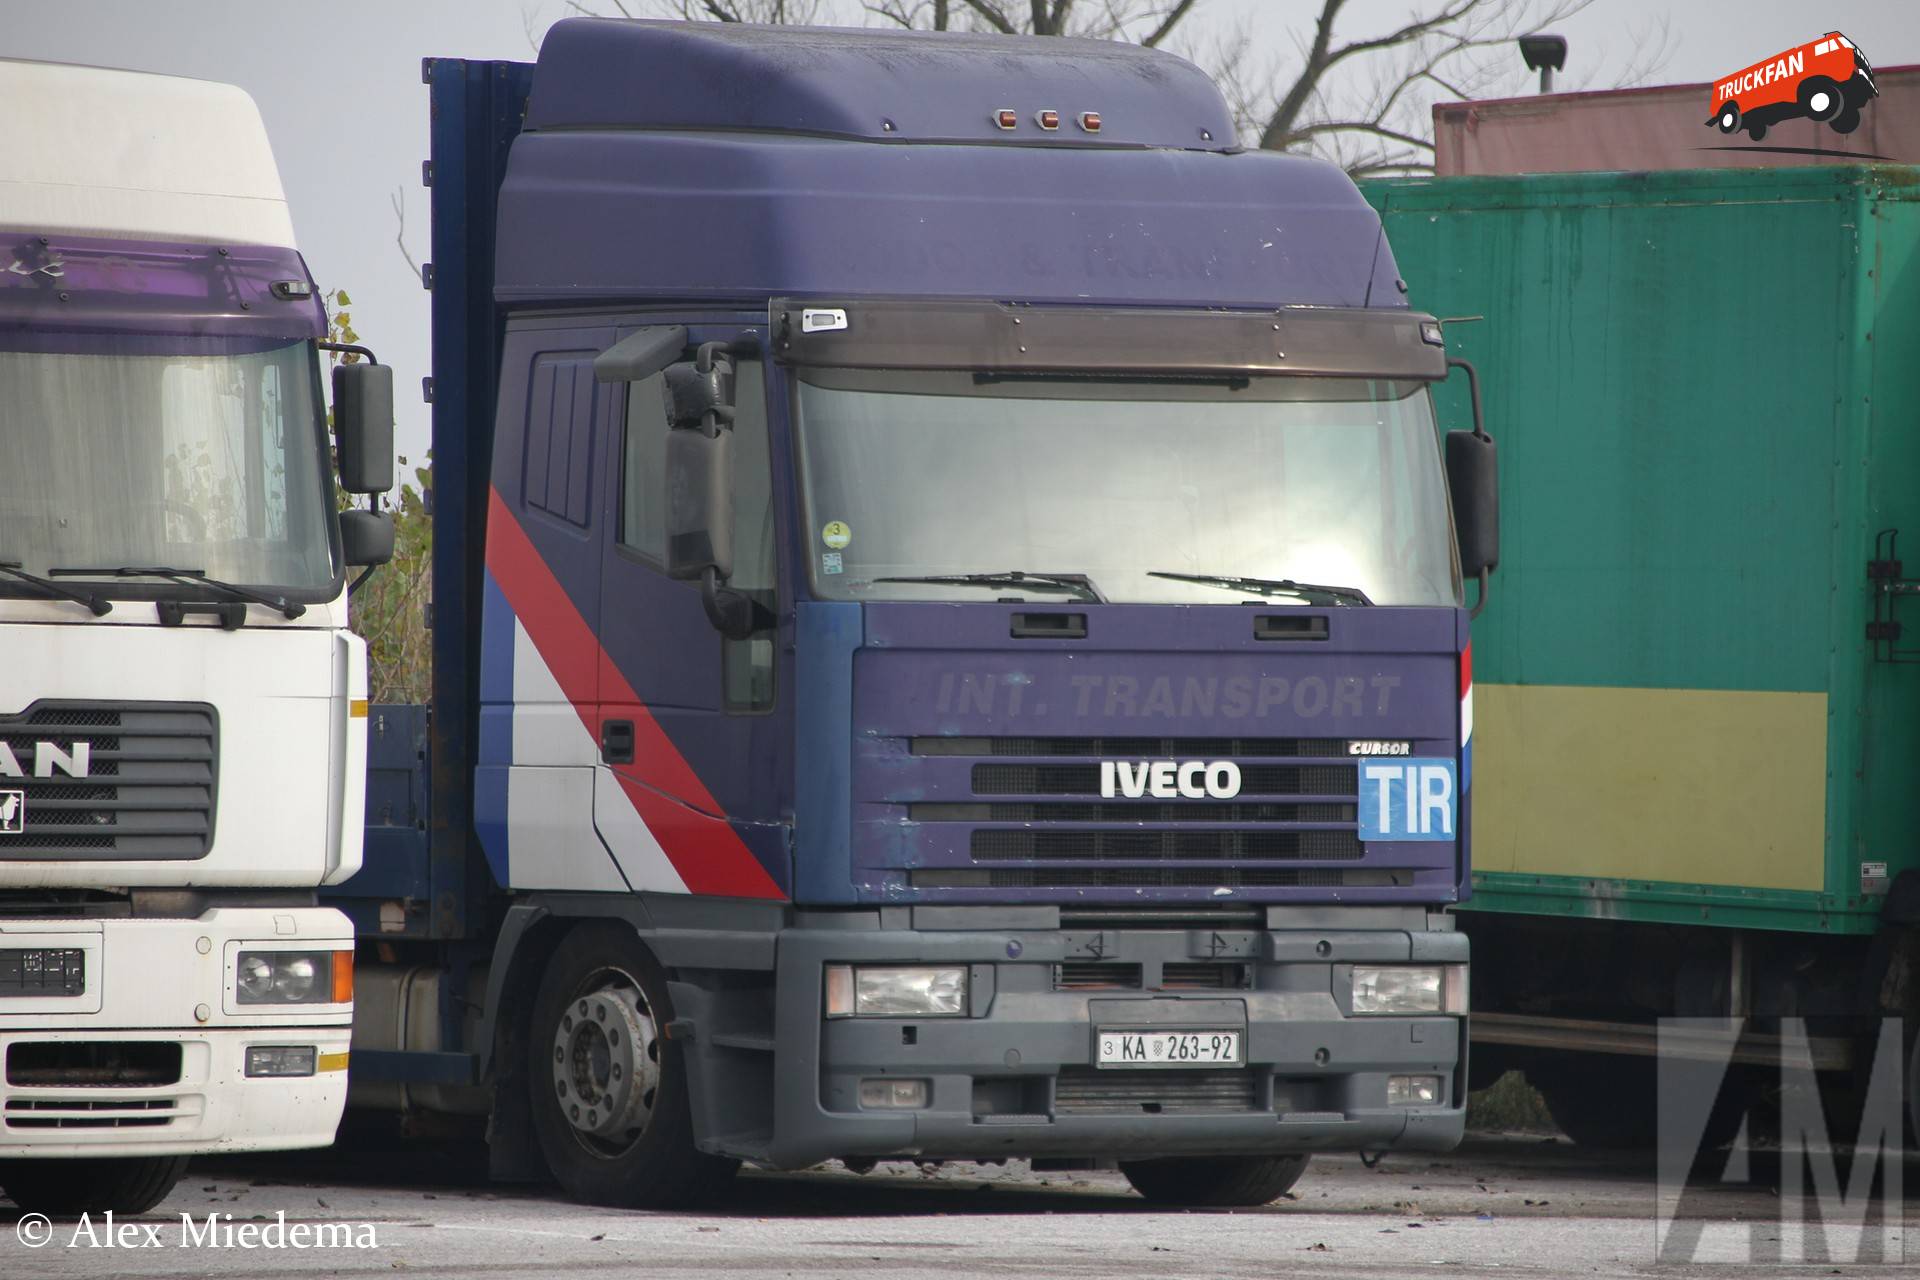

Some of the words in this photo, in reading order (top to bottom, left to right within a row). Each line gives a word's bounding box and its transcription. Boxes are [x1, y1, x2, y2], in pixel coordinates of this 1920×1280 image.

[935, 673, 1049, 716] INT.
[1071, 674, 1401, 719] TRANSPORT
[1348, 742, 1410, 756] CURSOR
[1101, 761, 1242, 798] IVECO
[1365, 766, 1452, 834] TIR
[1122, 1036, 1146, 1060] KA
[1167, 1035, 1233, 1060] 263-92
